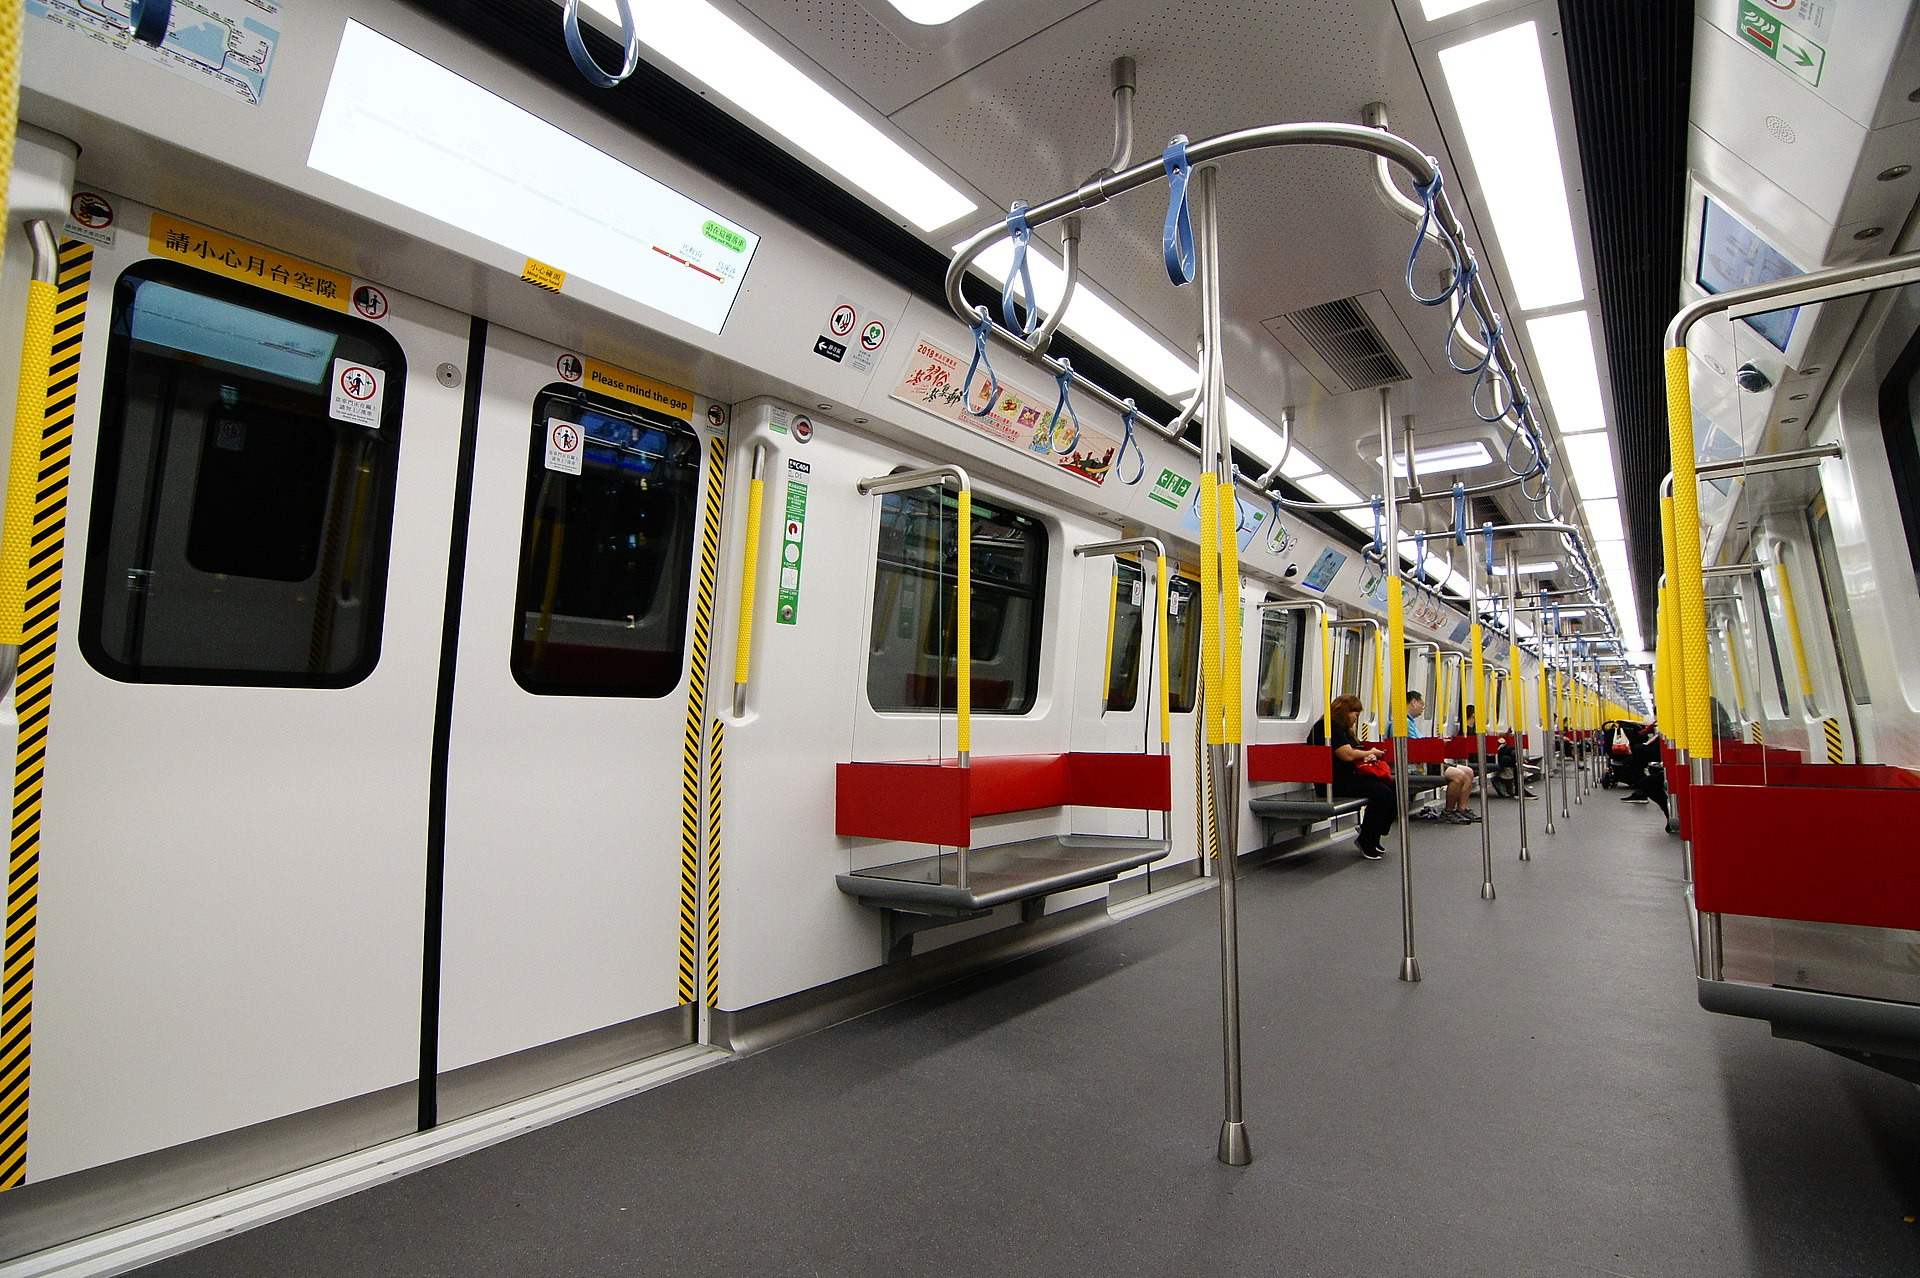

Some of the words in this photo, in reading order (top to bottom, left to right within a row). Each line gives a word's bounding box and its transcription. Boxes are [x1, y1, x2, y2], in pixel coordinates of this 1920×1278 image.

[705, 231, 718, 241] Please
[165, 228, 337, 300] 請小心月台空隙
[530, 263, 561, 281] 小心碰頭
[526, 270, 538, 278] Mind
[548, 278, 560, 286] head
[917, 344, 935, 359] 2018
[591, 370, 624, 390] Please
[626, 384, 651, 399] mind
[653, 391, 669, 404] the
[670, 398, 688, 412] gap
[795, 461, 809, 472] C404
